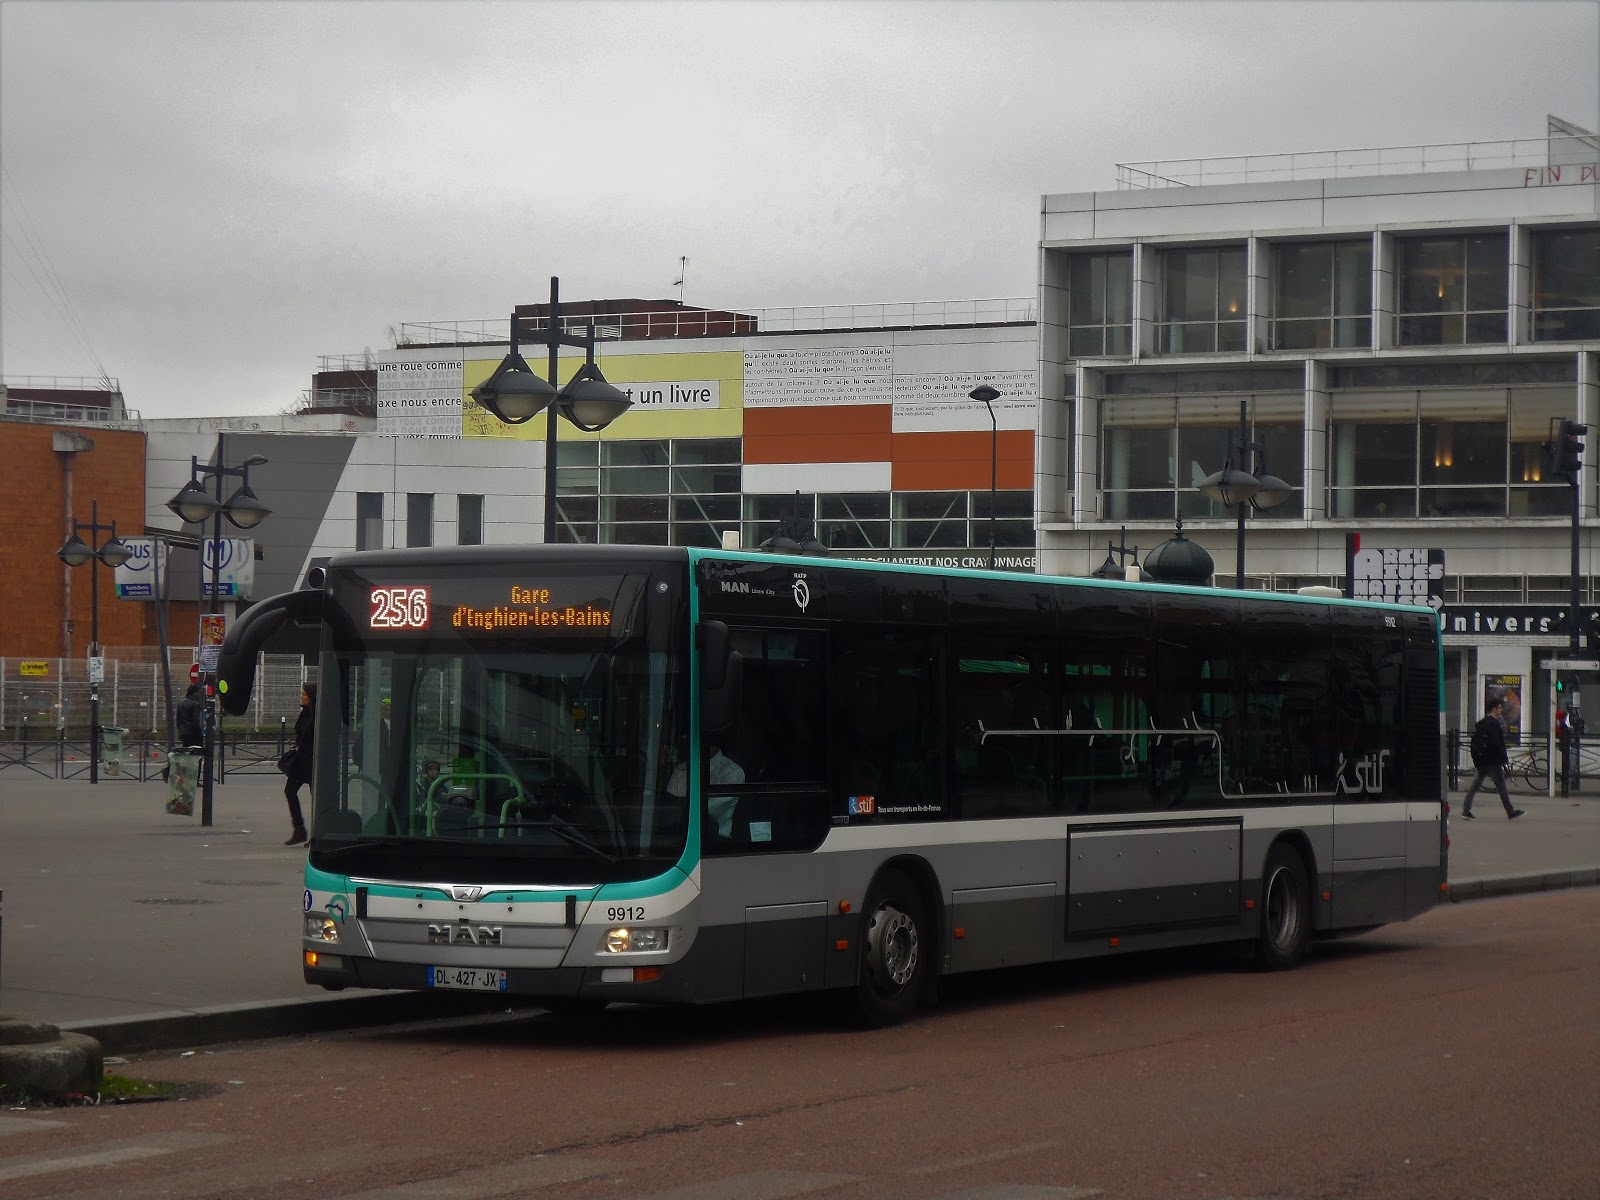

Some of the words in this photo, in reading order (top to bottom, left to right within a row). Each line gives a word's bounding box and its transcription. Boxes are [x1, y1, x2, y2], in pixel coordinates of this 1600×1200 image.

[1524, 165, 1560, 188] FIN
[379, 364, 398, 372] une
[400, 362, 422, 370] roue
[426, 361, 462, 370] comme
[402, 371, 428, 379] nous
[432, 370, 462, 378] encre
[640, 390, 662, 404] un
[670, 384, 710, 402] livre
[934, 384, 948, 392] ai-je
[402, 399, 427, 407] nous
[432, 398, 462, 406] encre
[936, 558, 958, 567] NOS
[511, 586, 549, 604] Gare
[721, 581, 750, 594] MAN
[1354, 580, 1428, 596] NATIO
[371, 588, 428, 627] 256
[452, 606, 610, 630] d'Enghien-les-Bains
[894, 806, 912, 814] transports
[608, 906, 644, 921] 9912
[428, 924, 503, 946] MAN
